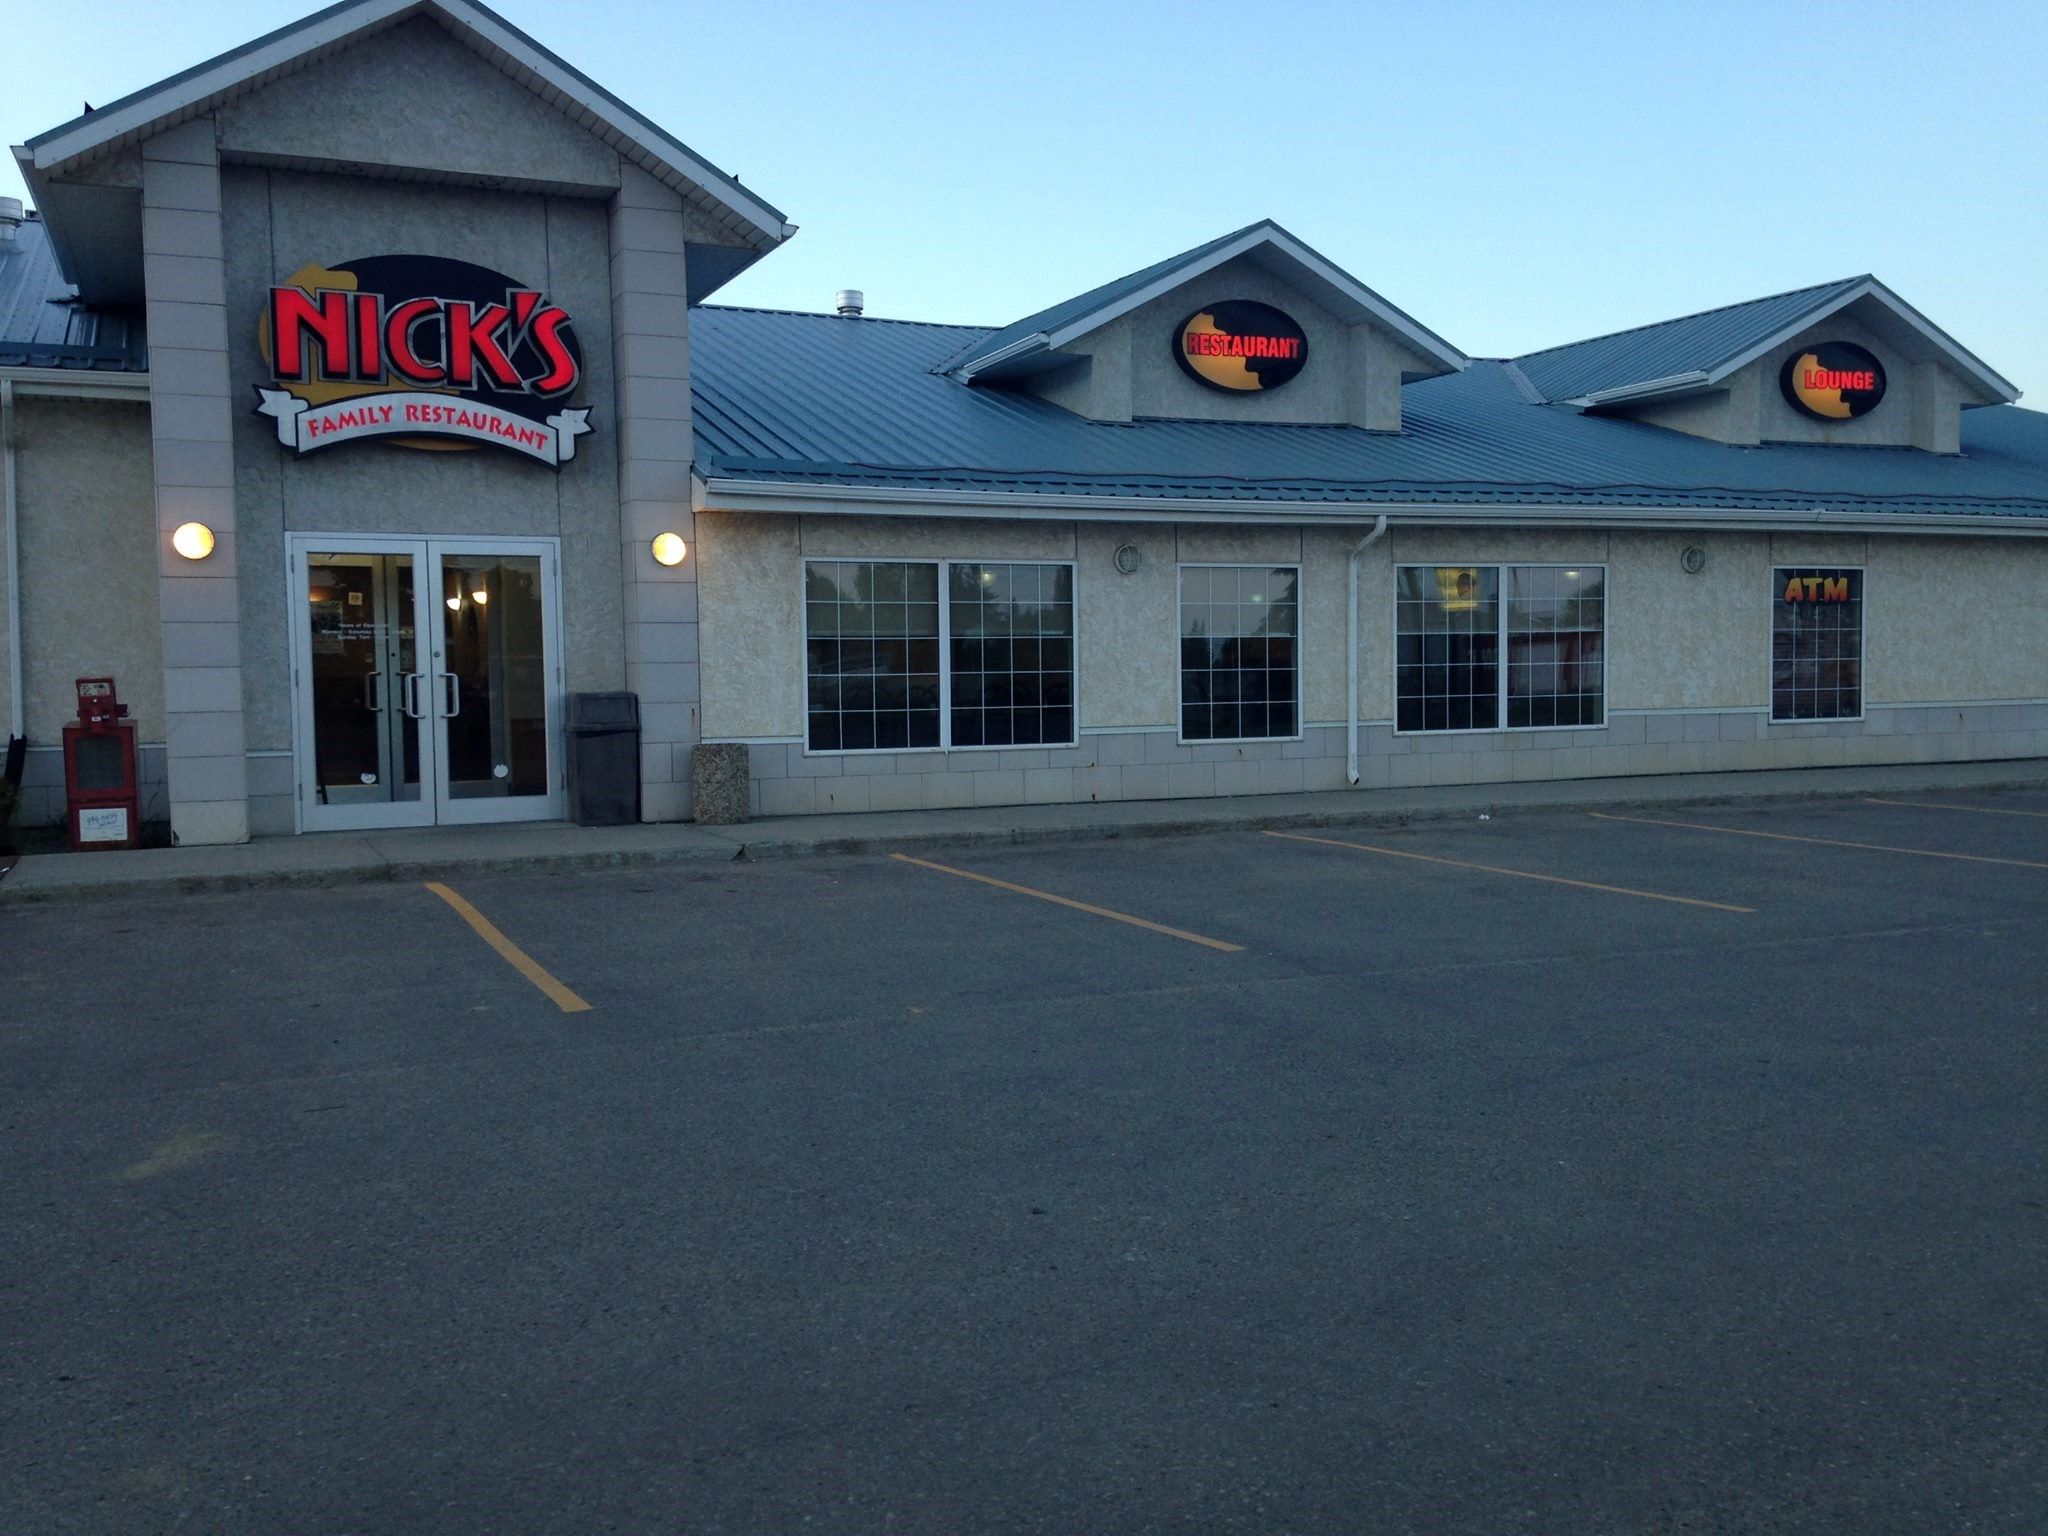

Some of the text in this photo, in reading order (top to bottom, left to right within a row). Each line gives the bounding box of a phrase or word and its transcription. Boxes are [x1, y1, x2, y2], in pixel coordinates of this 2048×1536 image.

[270, 286, 579, 399] NICK'S
[1187, 333, 1300, 359] RESTAURANT
[1803, 369, 1875, 391] LOUNGE
[307, 403, 549, 451] FAMILY RESTAURANT
[1784, 577, 1849, 603] ATM
